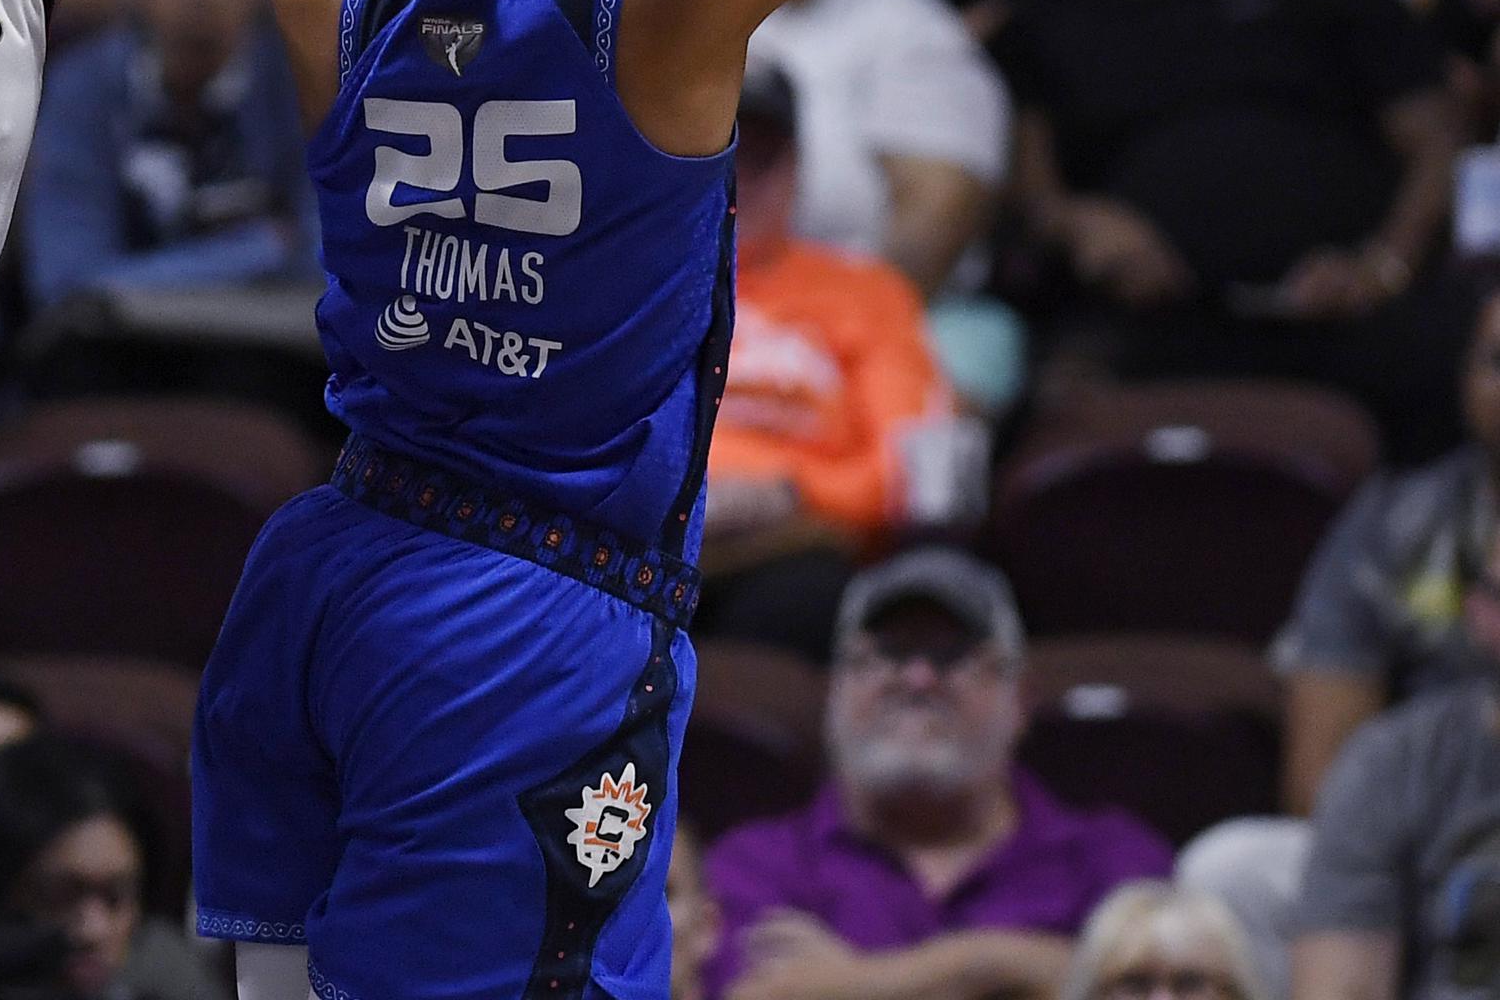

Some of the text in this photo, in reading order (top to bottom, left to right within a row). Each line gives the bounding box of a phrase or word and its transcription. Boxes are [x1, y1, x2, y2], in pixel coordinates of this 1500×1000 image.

[422, 23, 484, 35] FINALS
[363, 97, 583, 237] 25
[401, 225, 545, 305] THOMAS
[444, 318, 563, 379] AT&T
